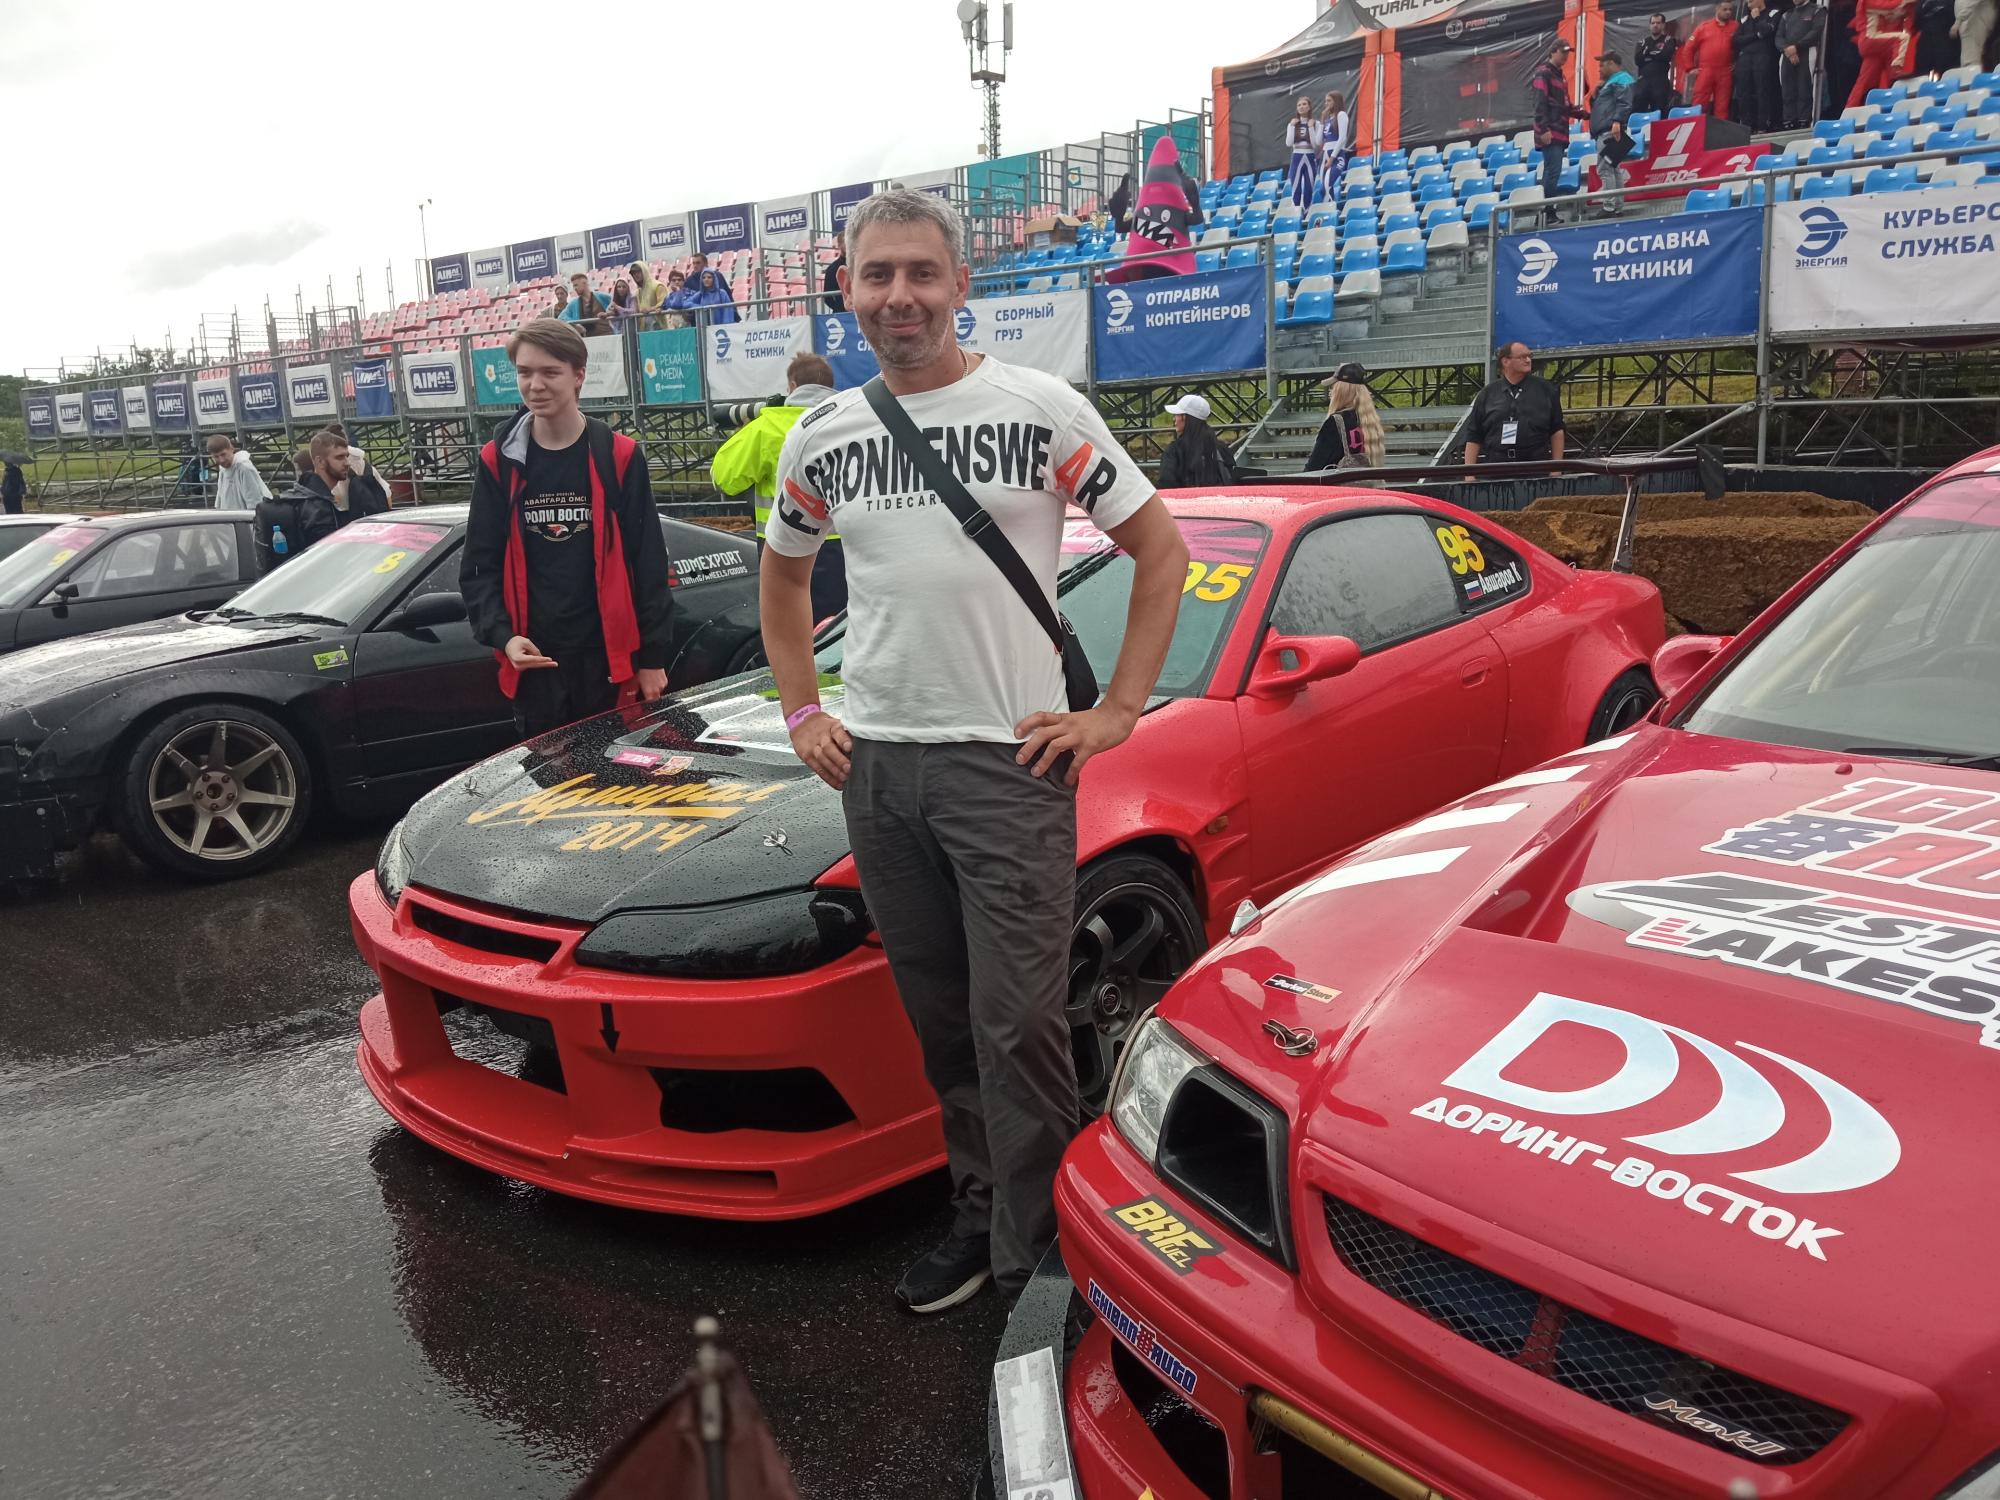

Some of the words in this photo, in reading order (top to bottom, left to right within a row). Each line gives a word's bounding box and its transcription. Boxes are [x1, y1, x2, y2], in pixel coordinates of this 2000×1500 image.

[1651, 121, 1697, 170] 1
[1593, 229, 1710, 260] ДОСТАВКА
[1881, 233, 1996, 260] СЛУЖБА
[1592, 258, 1693, 283] ТЕХНИКИ
[1795, 256, 1848, 268] ЭНЕРГИЯ
[1145, 285, 1220, 306] ОТПРАВКА
[1515, 282, 1559, 294] ЭНЕРГИЯ
[995, 302, 1055, 322] СБОРНЫЙ
[1145, 303, 1251, 328] КОНТЕЙНЕРОВ
[744, 328, 791, 344] ДОСТАВКА
[994, 328, 1023, 342] ГРУЗ
[744, 345, 785, 359] ТЕХНИКИ
[412, 370, 455, 390] AIMOL
[660, 367, 684, 380] MEDIA
[244, 386, 274, 406] AIMOL
[294, 380, 327, 402] AIMOL
[525, 496, 567, 506] АВАНГАРД
[866, 493, 945, 512] TIDECAR
[1436, 525, 1485, 575] 95
[373, 551, 407, 574] 8
[673, 550, 743, 575] JDMEXPORT
[1477, 568, 1516, 595] Авшаров
[1509, 561, 1523, 582] К
[559, 821, 707, 852] 2014
[1603, 874, 2000, 968] ZEST
[1274, 979, 1308, 993] Parker
[1306, 988, 1333, 1001] Store
[1409, 1096, 1845, 1262] ДОРИНГ-ВОСТОК
